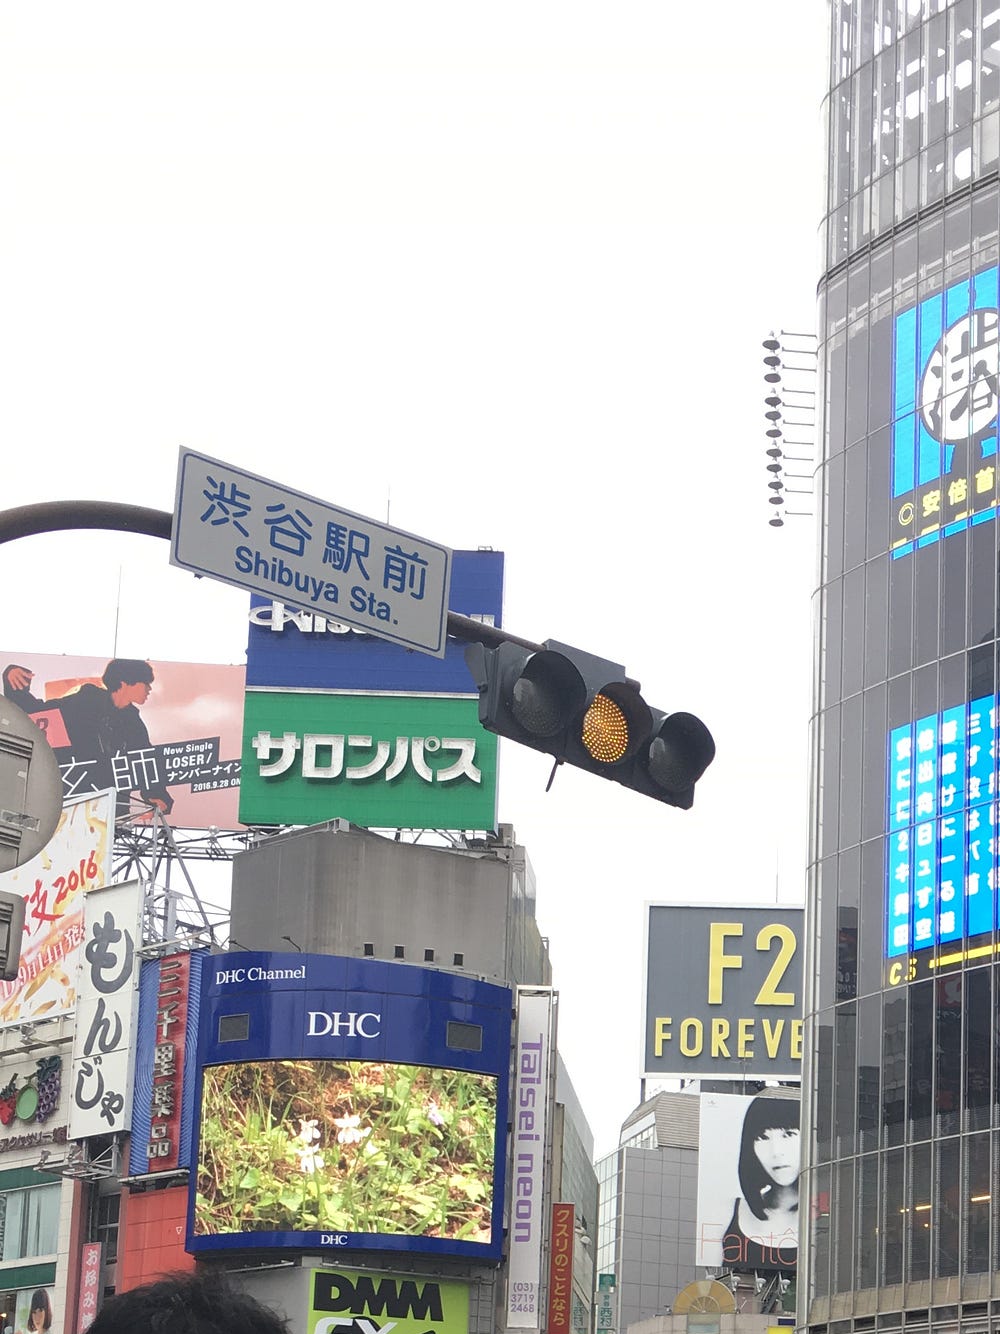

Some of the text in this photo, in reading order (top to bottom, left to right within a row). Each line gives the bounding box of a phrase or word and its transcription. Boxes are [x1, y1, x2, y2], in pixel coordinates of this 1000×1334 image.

[201, 476, 428, 600] 渋谷駅前
[235, 546, 339, 603] Shibuya
[350, 586, 399, 625] Sta.
[163, 742, 213, 756] New Single
[167, 761, 242, 782] ナンバーナイン
[251, 730, 483, 785] サロンパス
[193, 780, 229, 792] 2016.9.28
[52, 850, 98, 904] 2016
[18, 921, 85, 986] 9月14日発
[215, 964, 306, 985] DHC Channel
[708, 923, 797, 1005] F2
[75, 911, 134, 1127] もんじゃ
[307, 1010, 381, 1038] DHC
[654, 1017, 803, 1059] FOREVE
[147, 960, 181, 1159] 三千里薬品
[515, 1032, 543, 1243] Taisei neon
[320, 1233, 348, 1246] DHC
[513, 1282, 533, 1292] (03)
[553, 1209, 570, 1327] クスリのことなら
[313, 1271, 444, 1322] DMM
[510, 1293, 534, 1303] 3719
[510, 1304, 535, 1313] 2468
